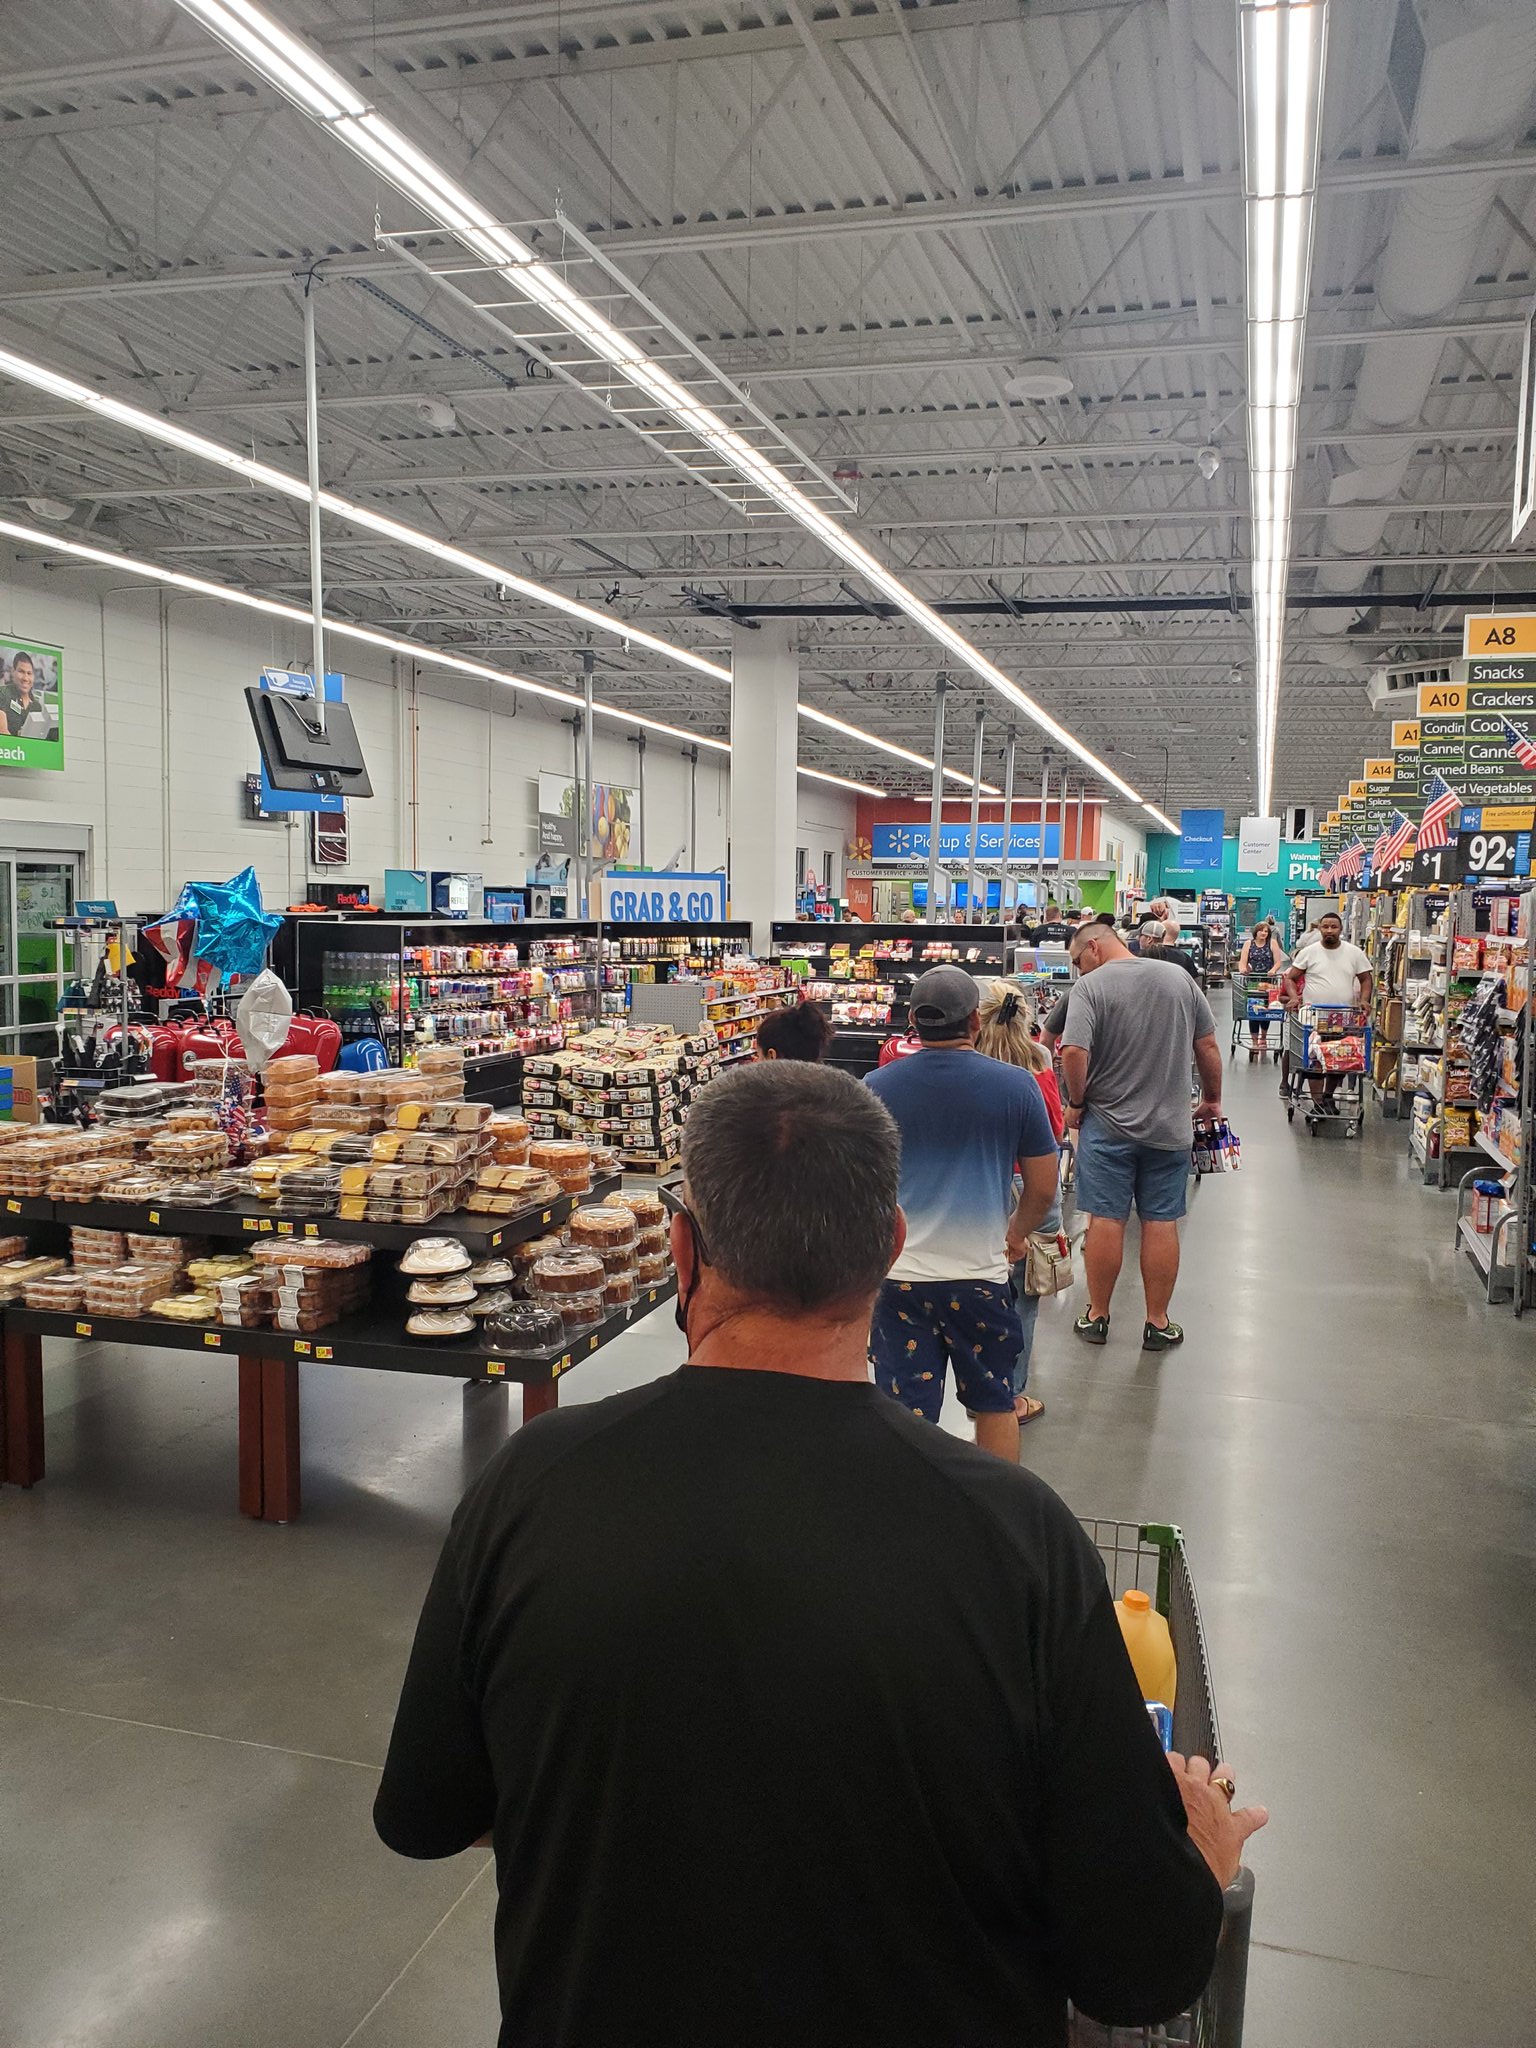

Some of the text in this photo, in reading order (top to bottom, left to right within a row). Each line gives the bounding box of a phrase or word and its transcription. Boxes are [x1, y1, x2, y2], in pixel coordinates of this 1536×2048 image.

[1484, 627, 1516, 646] A8
[1473, 664, 1525, 680] Snacks
[1429, 692, 1460, 707] A10
[1471, 691, 1534, 707] Crackers
[1403, 729, 1418, 741] A1
[1469, 744, 1517, 759] Canne
[1372, 765, 1392, 776] A14
[1397, 770, 1415, 780] Box
[1422, 763, 1504, 776] Canned Beans
[1356, 786, 1366, 794] A1
[1368, 784, 1390, 794] Sugar
[1422, 783, 1533, 797] Ced Vegetables
[1368, 797, 1392, 807] Spices
[1367, 811, 1409, 819] Cake Mes
[1447, 837, 1458, 847] Pri
[1289, 853, 1321, 861] Walmar
[1468, 835, 1516, 871] 92¢
[1422, 852, 1441, 880] $1
[610, 890, 713, 922] GRAB & GO
